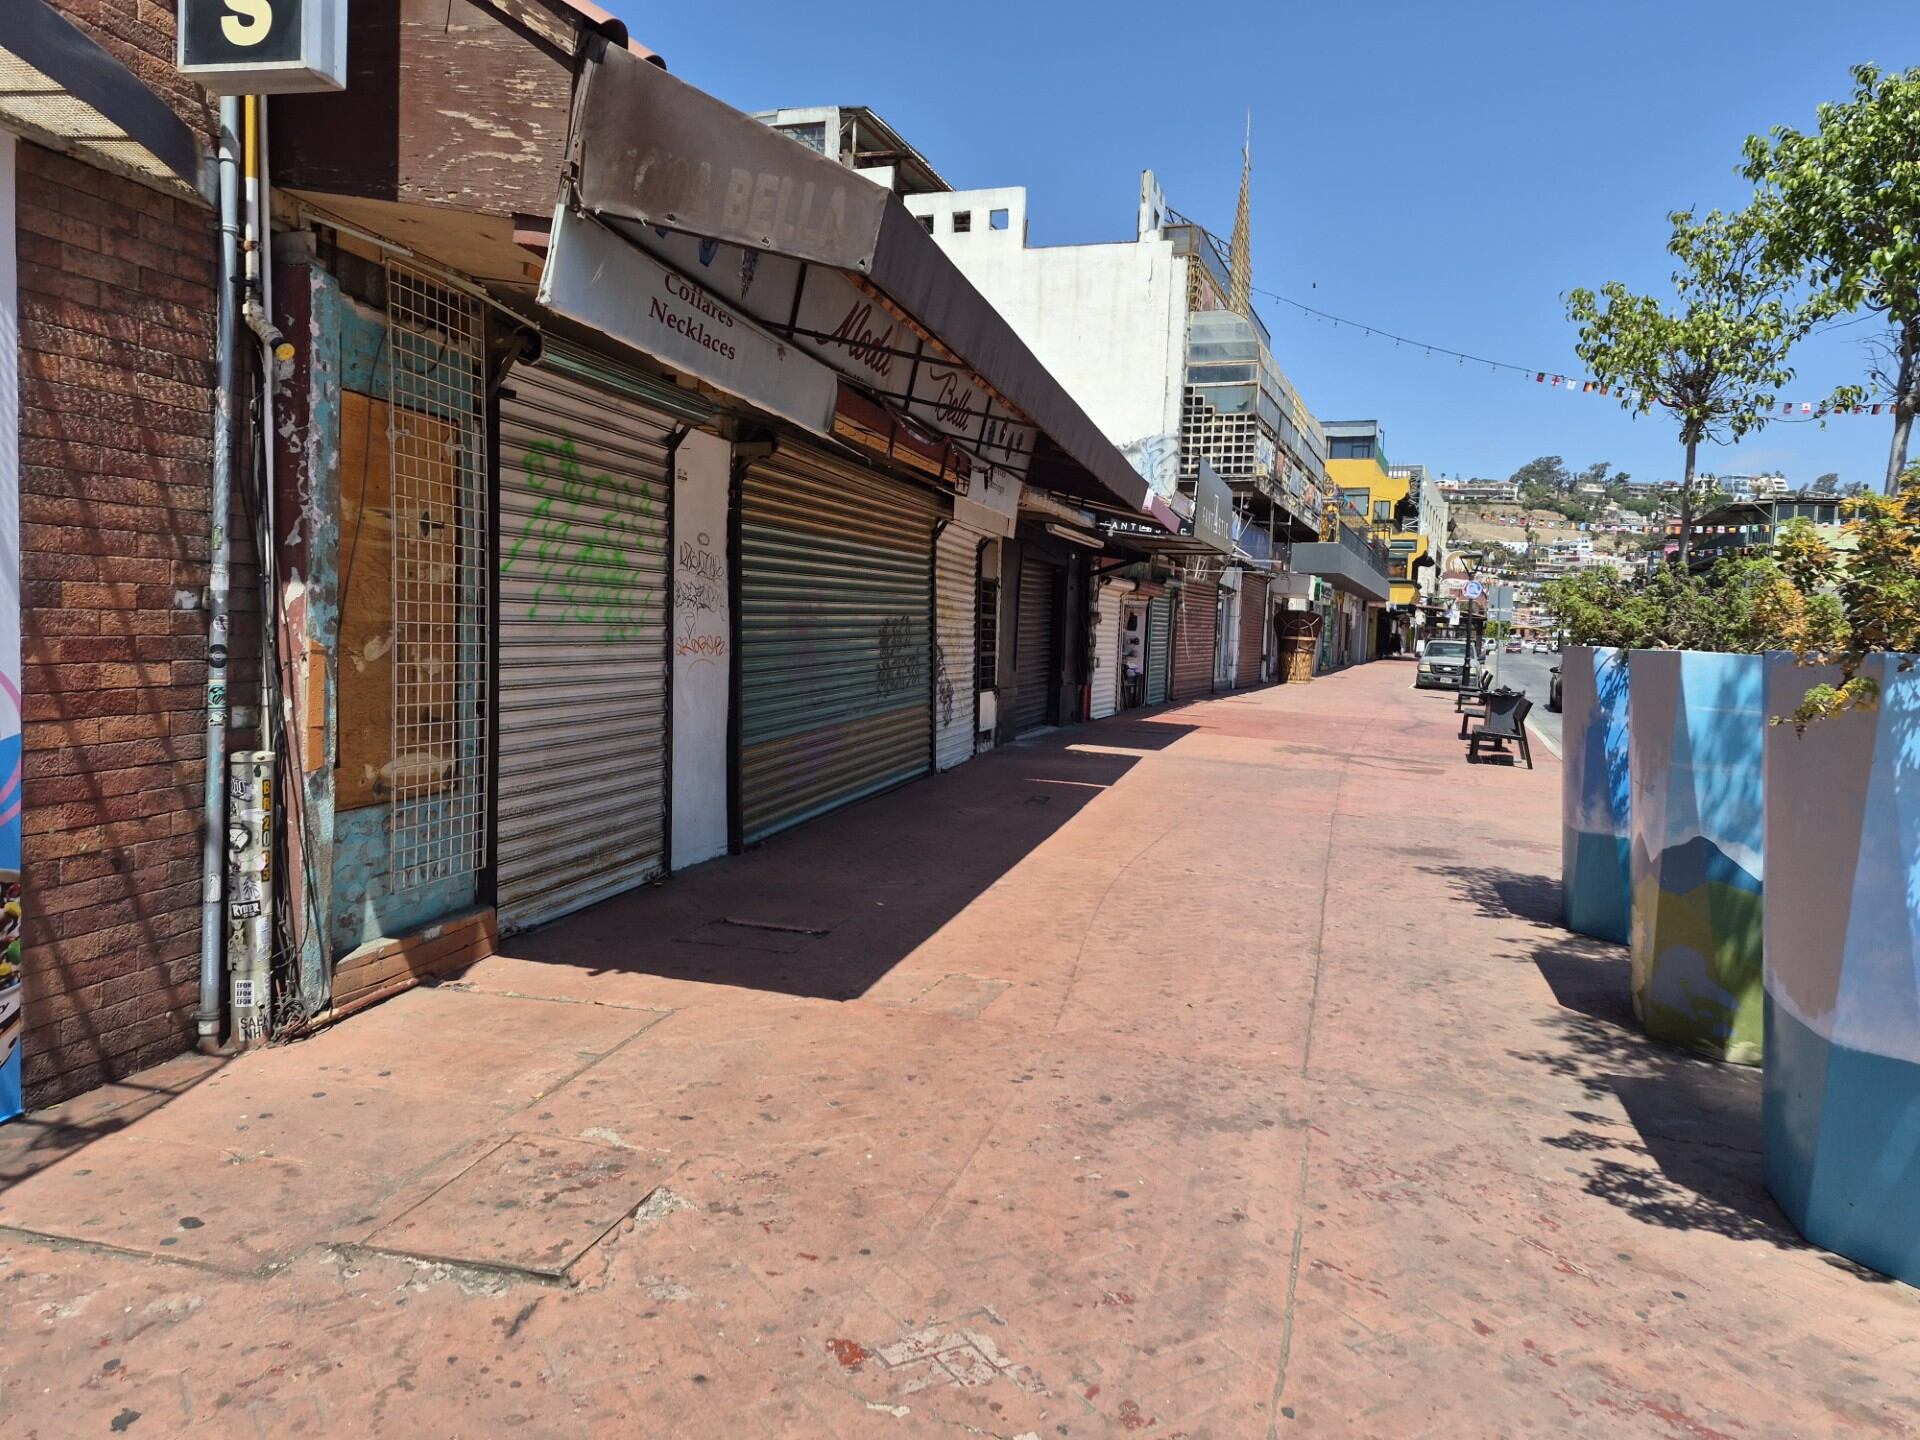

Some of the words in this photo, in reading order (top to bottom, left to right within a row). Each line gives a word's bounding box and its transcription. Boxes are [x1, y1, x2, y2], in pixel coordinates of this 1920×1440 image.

[220, 0, 273, 47] S
[723, 167, 847, 249] BELLA
[648, 296, 735, 360] Necklaces
[815, 300, 892, 377] Moda
[930, 366, 974, 432] Bella
[231, 902, 260, 918] RYDER
